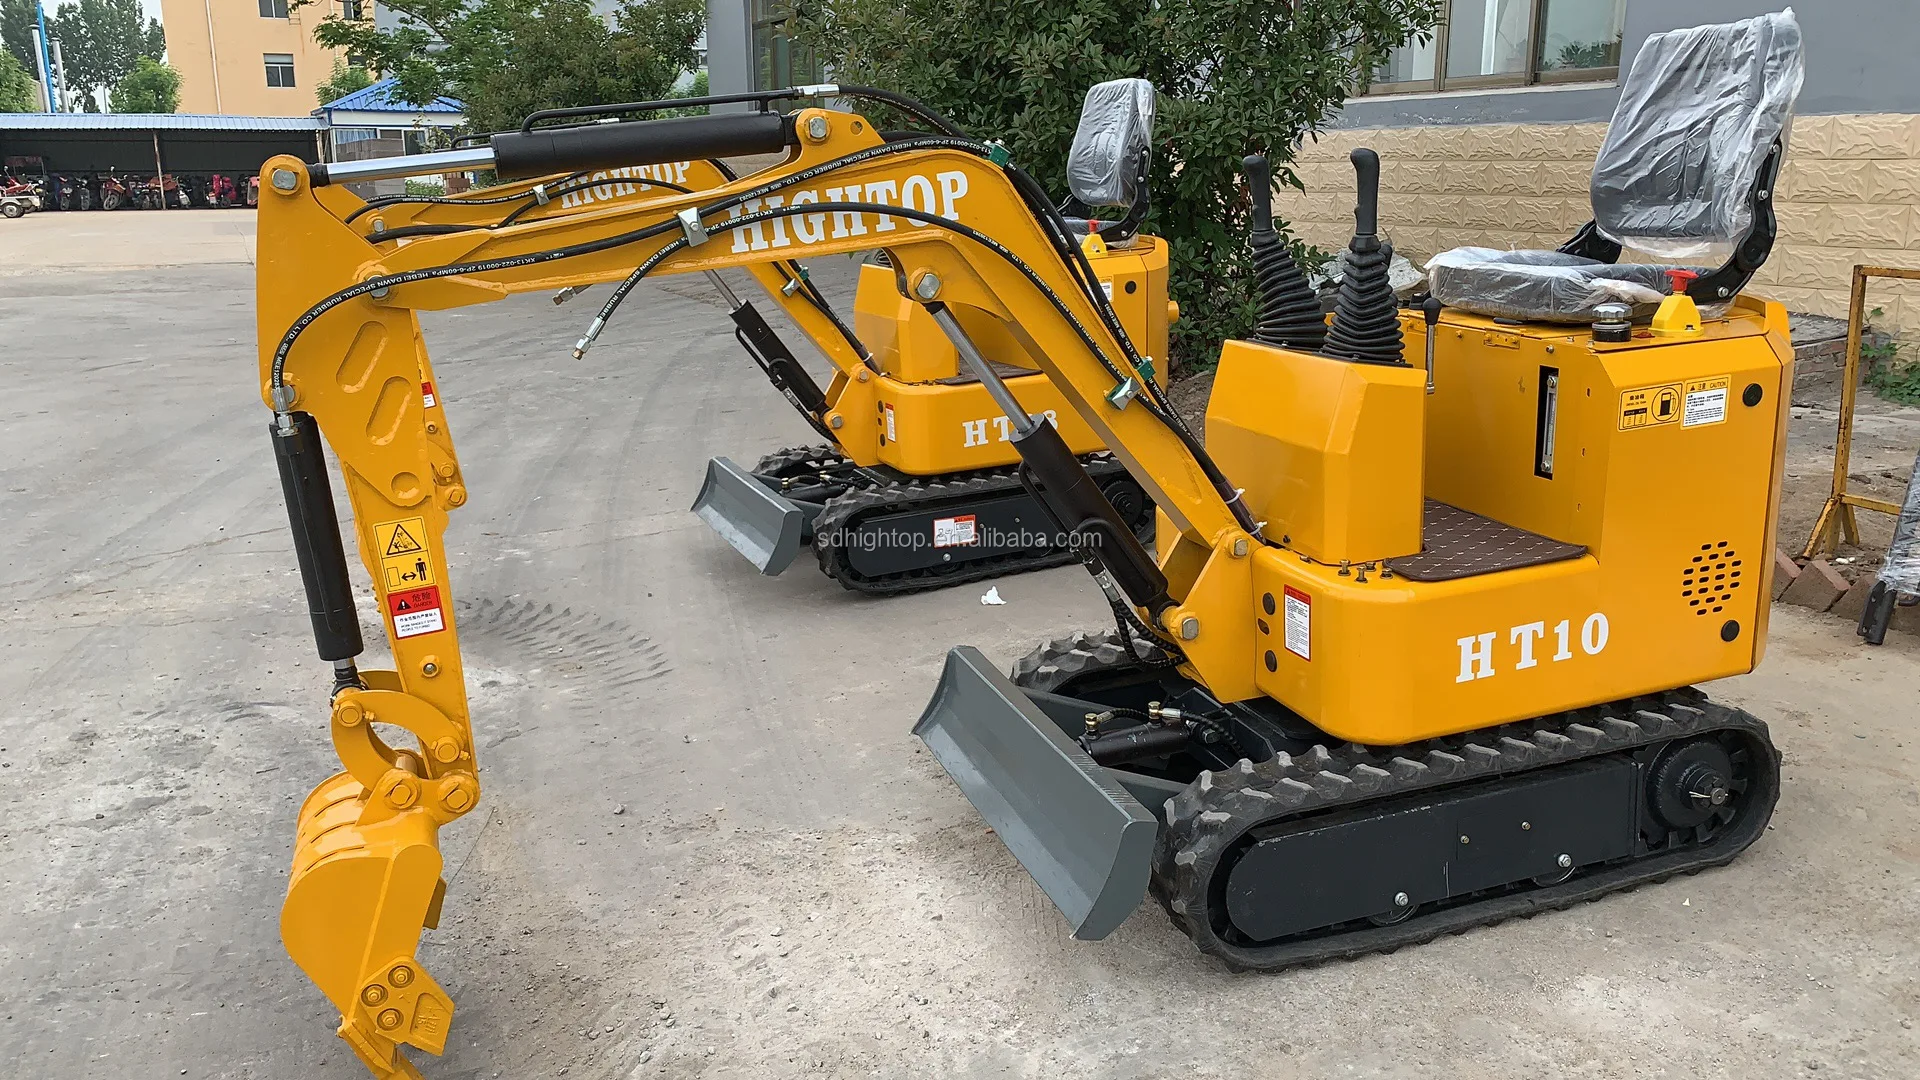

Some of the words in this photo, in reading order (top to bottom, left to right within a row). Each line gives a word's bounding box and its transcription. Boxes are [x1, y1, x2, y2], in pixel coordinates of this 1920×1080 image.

[842, 152, 871, 166] SPECIAL
[870, 146, 892, 158] DAWN
[814, 162, 842, 176] RUBBER
[558, 161, 690, 209] HIGHTOP
[724, 170, 969, 255] HIGHTOP
[658, 240, 680, 256] HEBEI
[478, 256, 536, 272] XK13-022-00019
[640, 254, 660, 276] DAWN
[377, 275, 403, 289] DAWN
[403, 271, 429, 282] HEBEI
[618, 268, 641, 296] SPECIAL
[1032, 271, 1051, 292] RUBBER
[343, 282, 376, 299] SPECIAL
[311, 295, 343, 317] RUBBER
[1051, 291, 1070, 312] SPECIAL
[1152, 383, 1168, 405] SPECIAL
[1166, 403, 1179, 420] DAWN
[962, 409, 1059, 448] HT8
